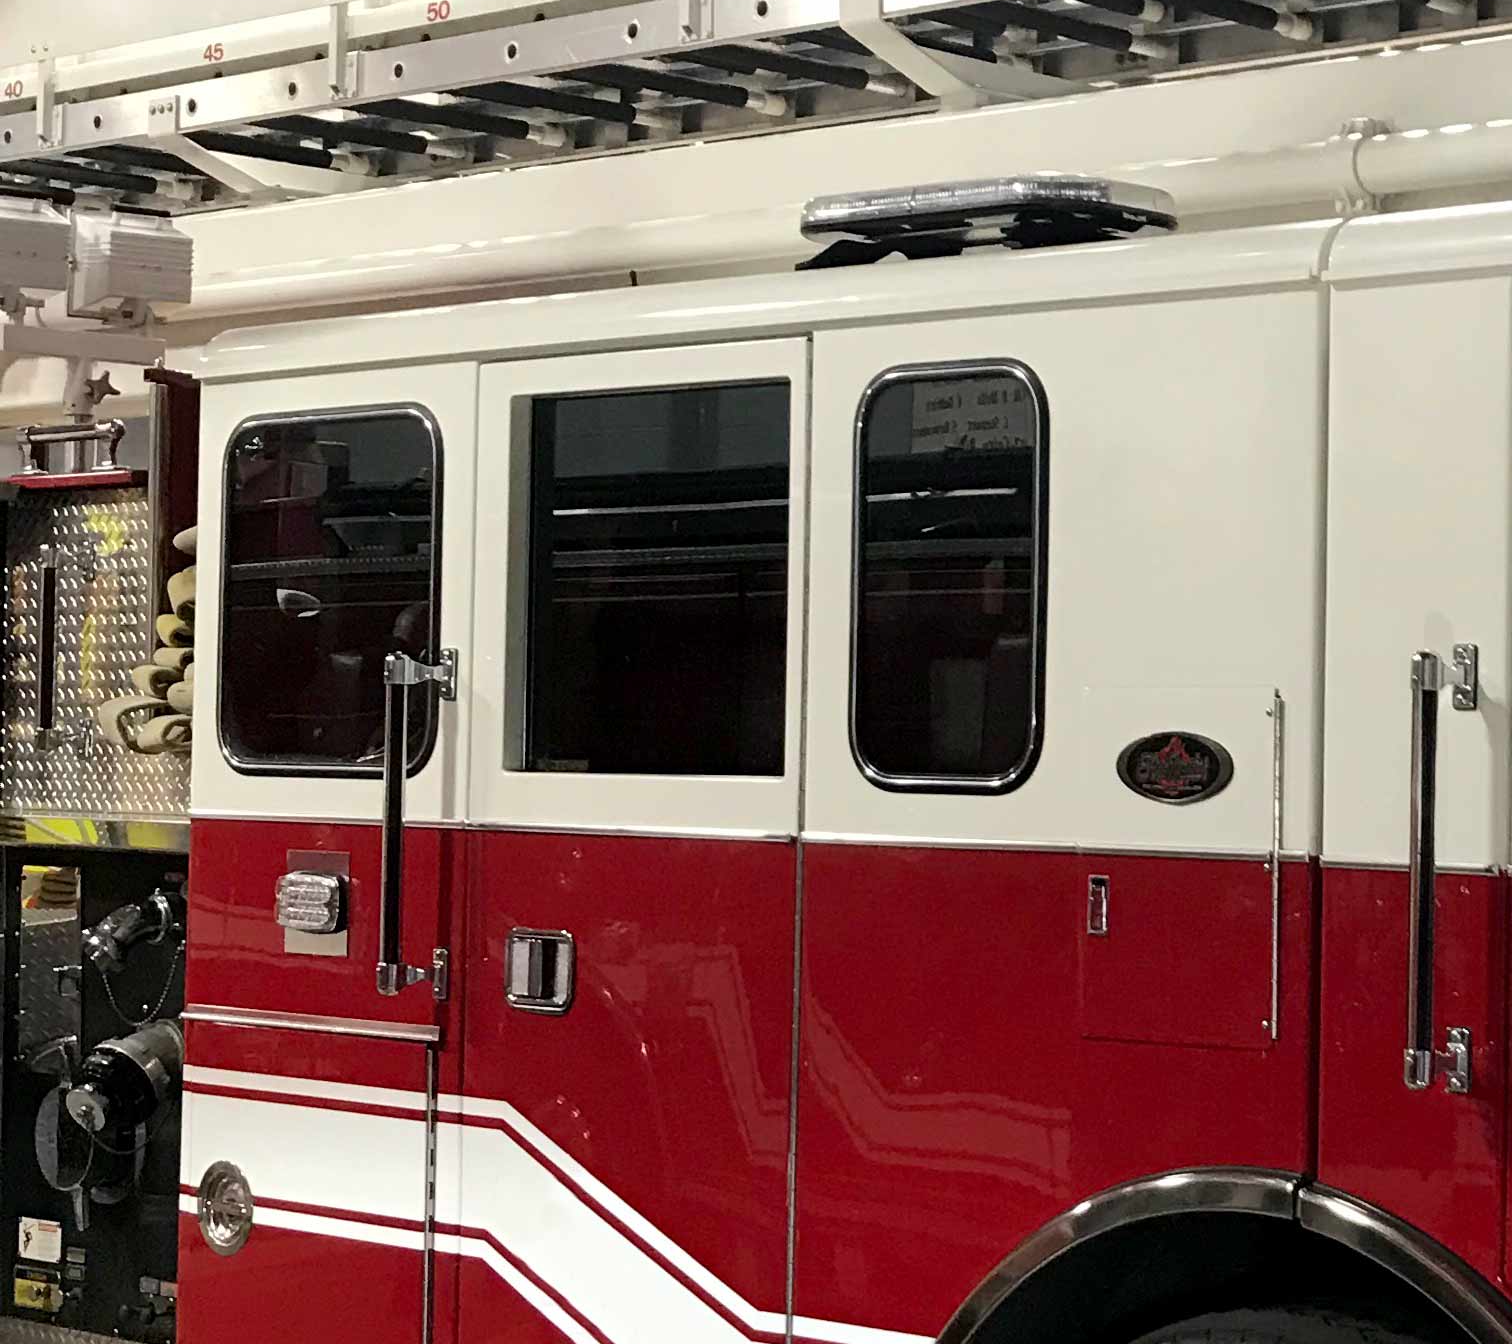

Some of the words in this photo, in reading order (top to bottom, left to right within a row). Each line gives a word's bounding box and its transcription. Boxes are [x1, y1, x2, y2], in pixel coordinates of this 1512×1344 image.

[426, 0, 451, 22] 50
[203, 43, 225, 62] 45
[4, 80, 24, 98] 40
